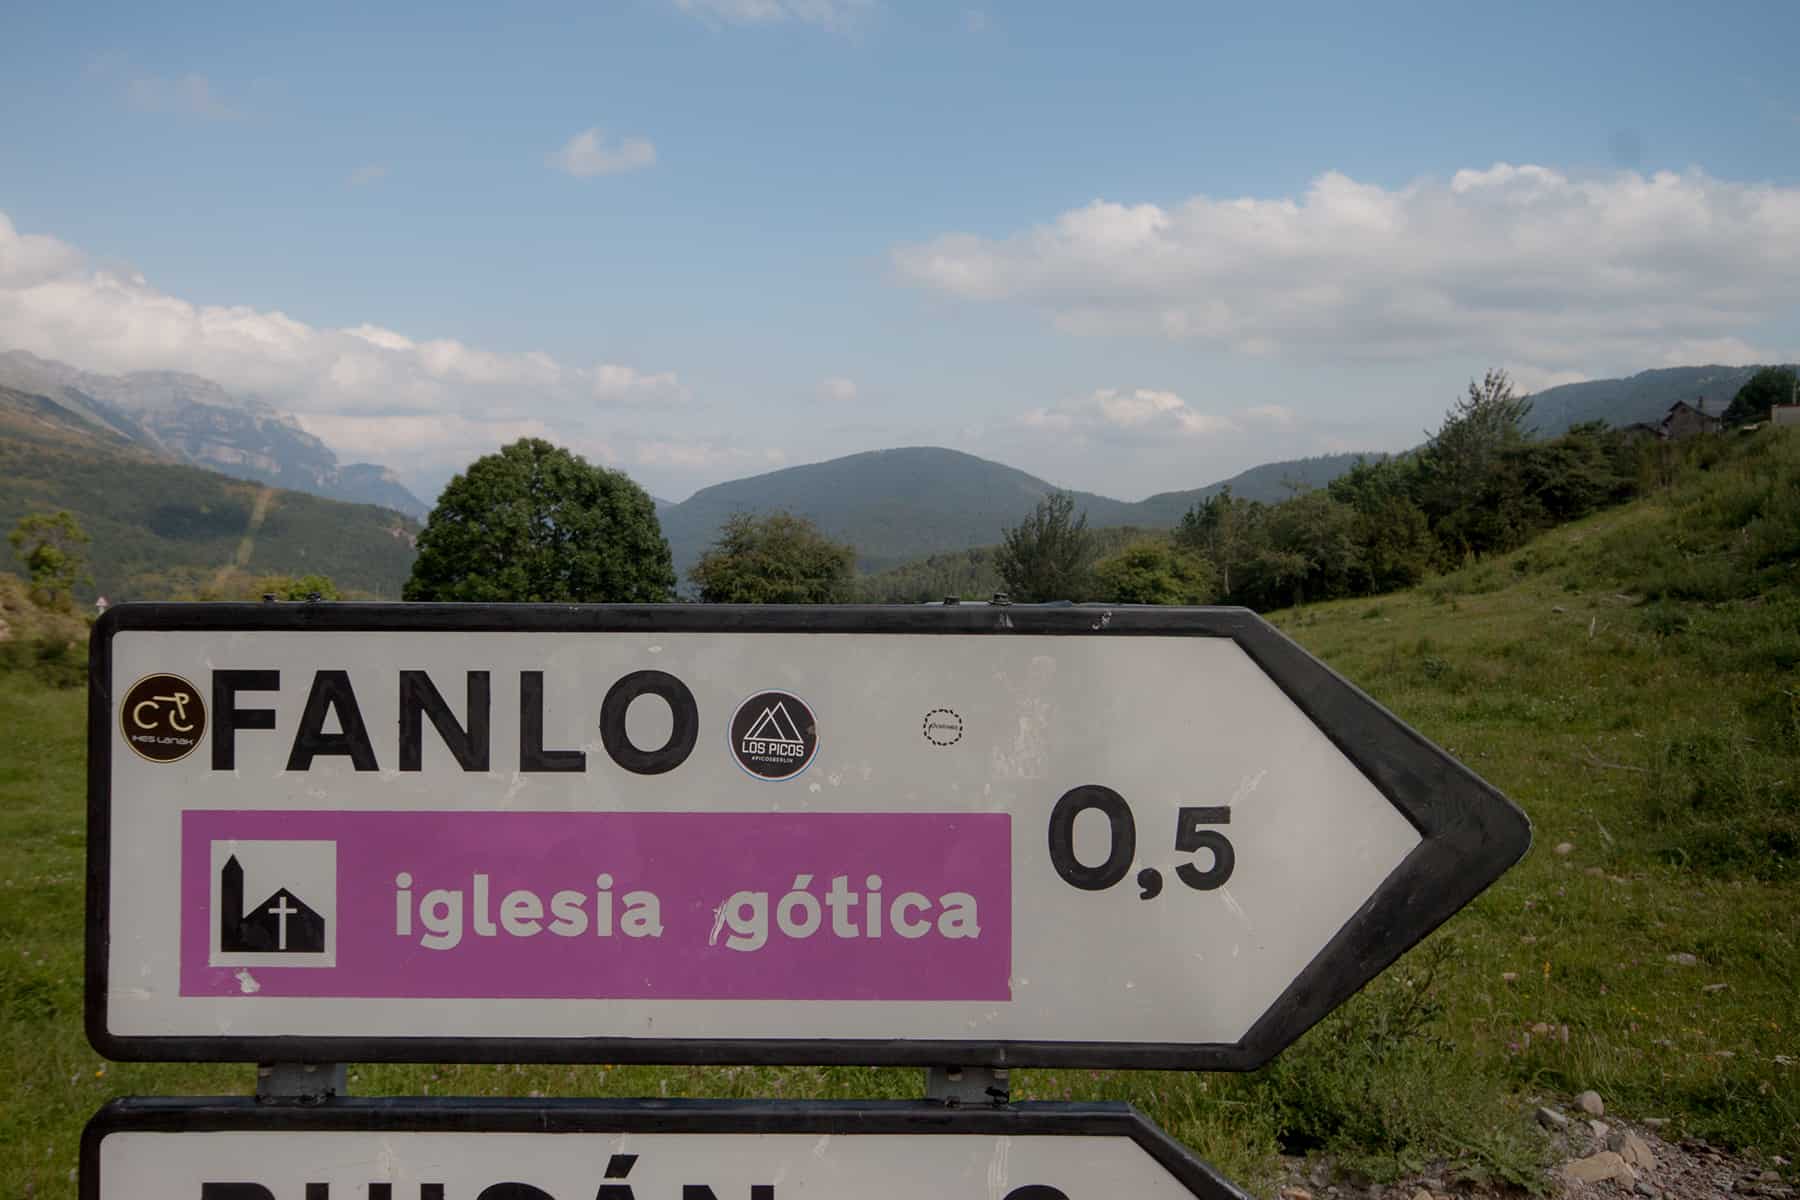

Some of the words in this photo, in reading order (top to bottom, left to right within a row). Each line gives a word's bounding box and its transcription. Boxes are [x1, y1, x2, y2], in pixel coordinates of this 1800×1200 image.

[211, 669, 700, 776] FANLO
[742, 741, 766, 754] LOS
[768, 743, 805, 757] PICOS
[1047, 784, 1236, 901] 0,5
[395, 871, 665, 951] iglesia
[724, 874, 982, 952] gótica
